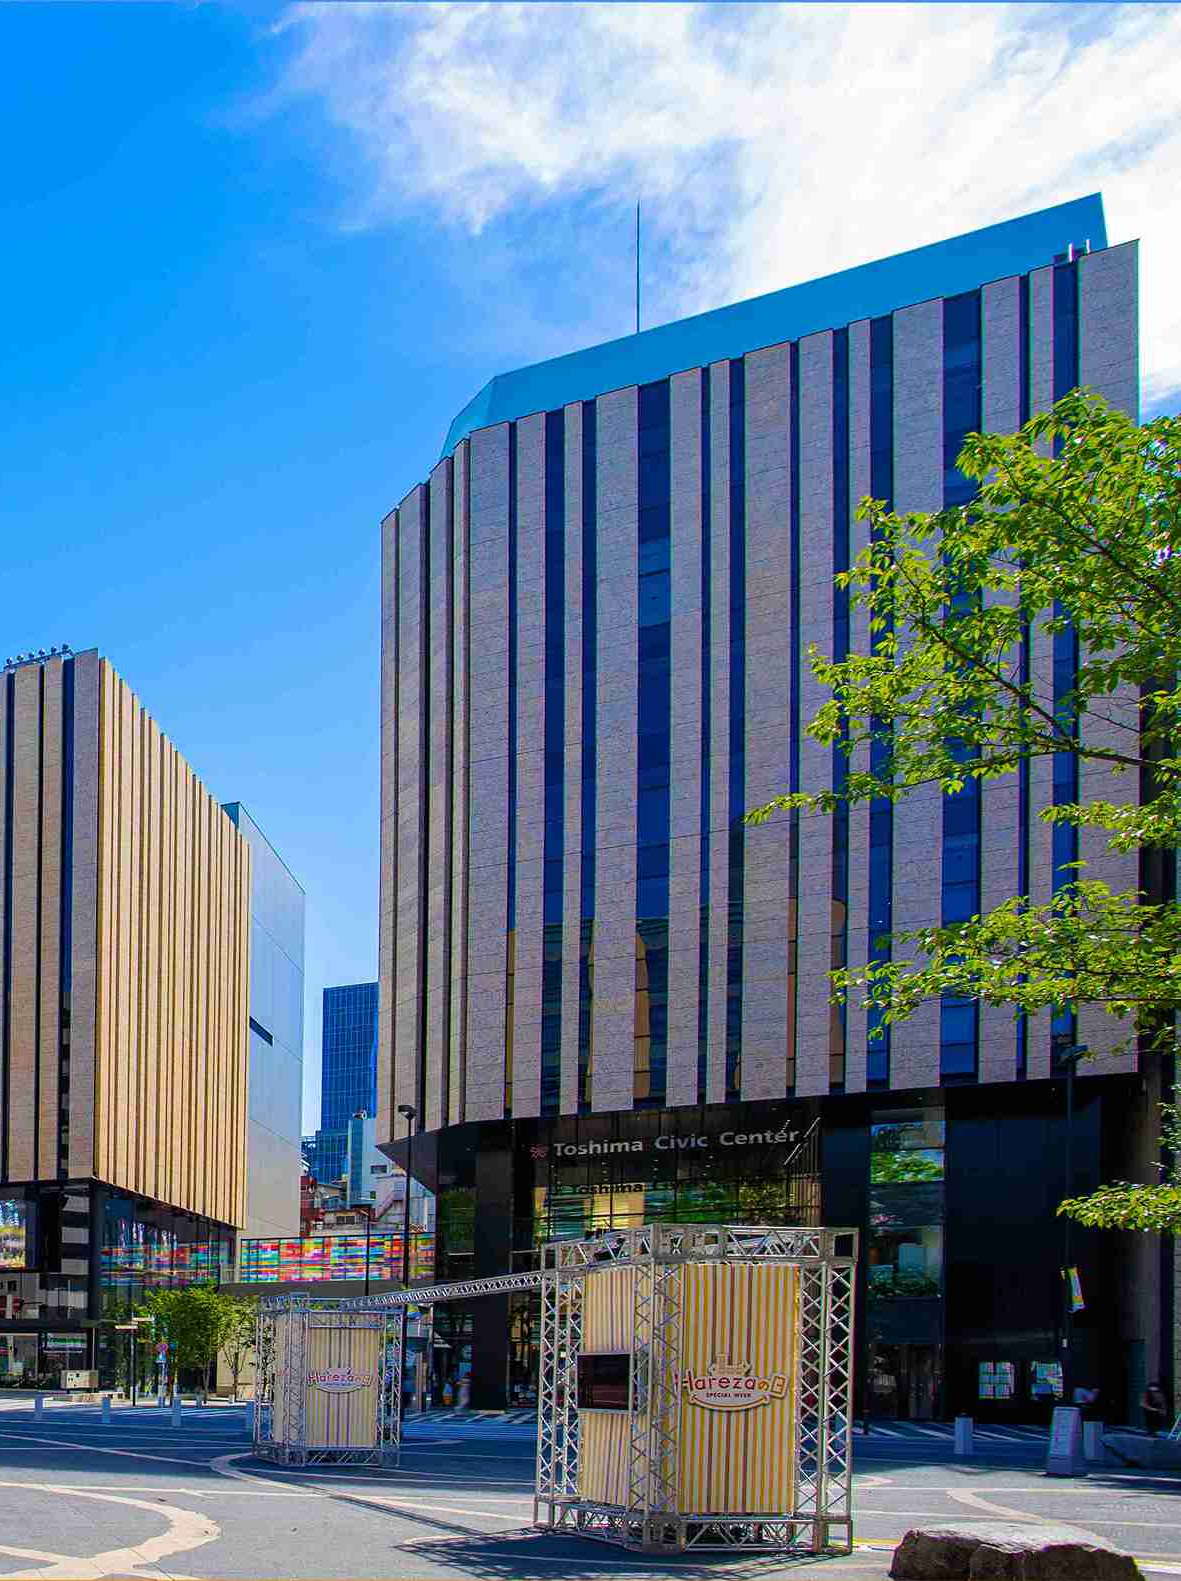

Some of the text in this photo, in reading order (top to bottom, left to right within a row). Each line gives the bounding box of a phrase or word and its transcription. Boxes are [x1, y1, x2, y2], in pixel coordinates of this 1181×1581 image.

[554, 1129, 800, 1157] Toshima Civic Center
[705, 1391, 731, 1399] SPECIAL
